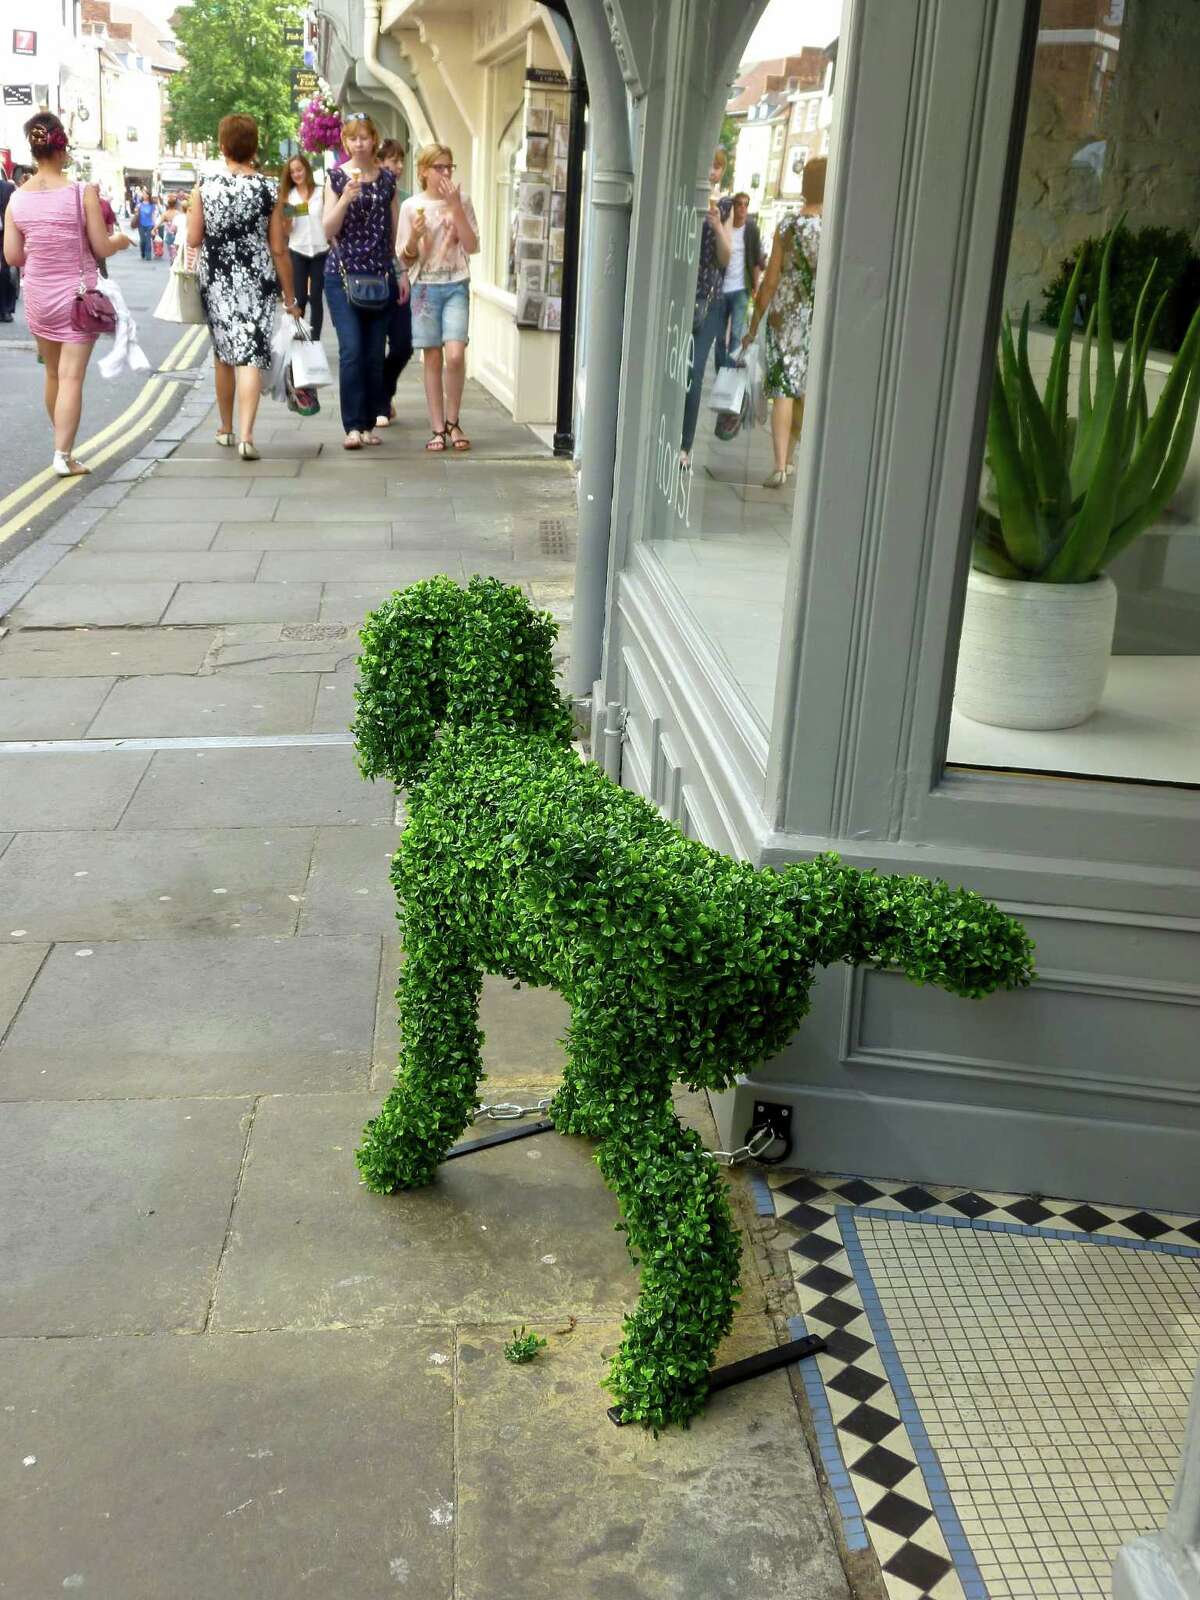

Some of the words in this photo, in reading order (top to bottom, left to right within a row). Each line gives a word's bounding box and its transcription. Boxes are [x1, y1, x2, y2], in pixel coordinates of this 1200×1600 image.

[674, 184, 698, 265] the
[664, 299, 695, 393] fake
[656, 414, 694, 529] florist
